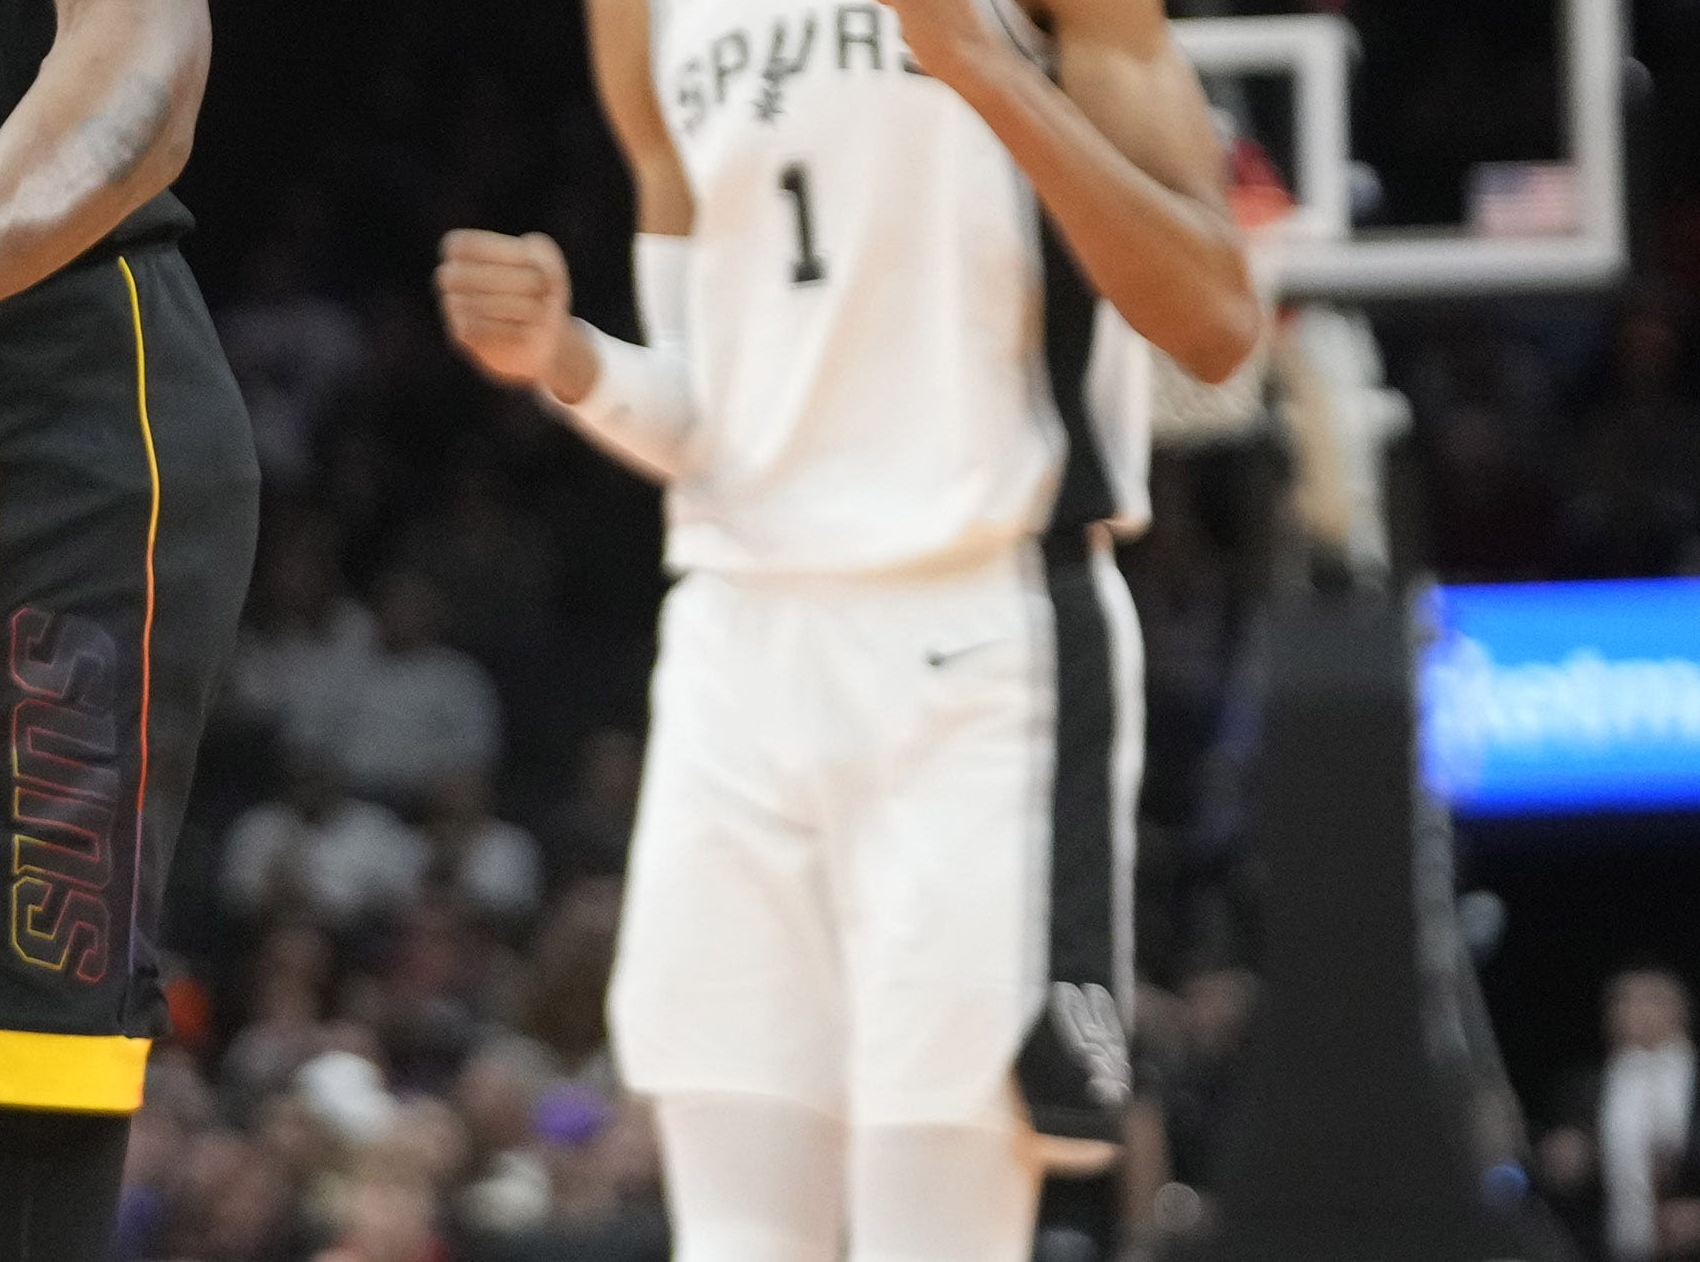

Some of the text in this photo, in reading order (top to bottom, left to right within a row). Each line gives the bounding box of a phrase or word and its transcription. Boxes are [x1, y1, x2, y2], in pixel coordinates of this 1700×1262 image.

[677, 2, 928, 136] SPUR
[777, 160, 827, 284] 1
[10, 606, 120, 984] SUNS
